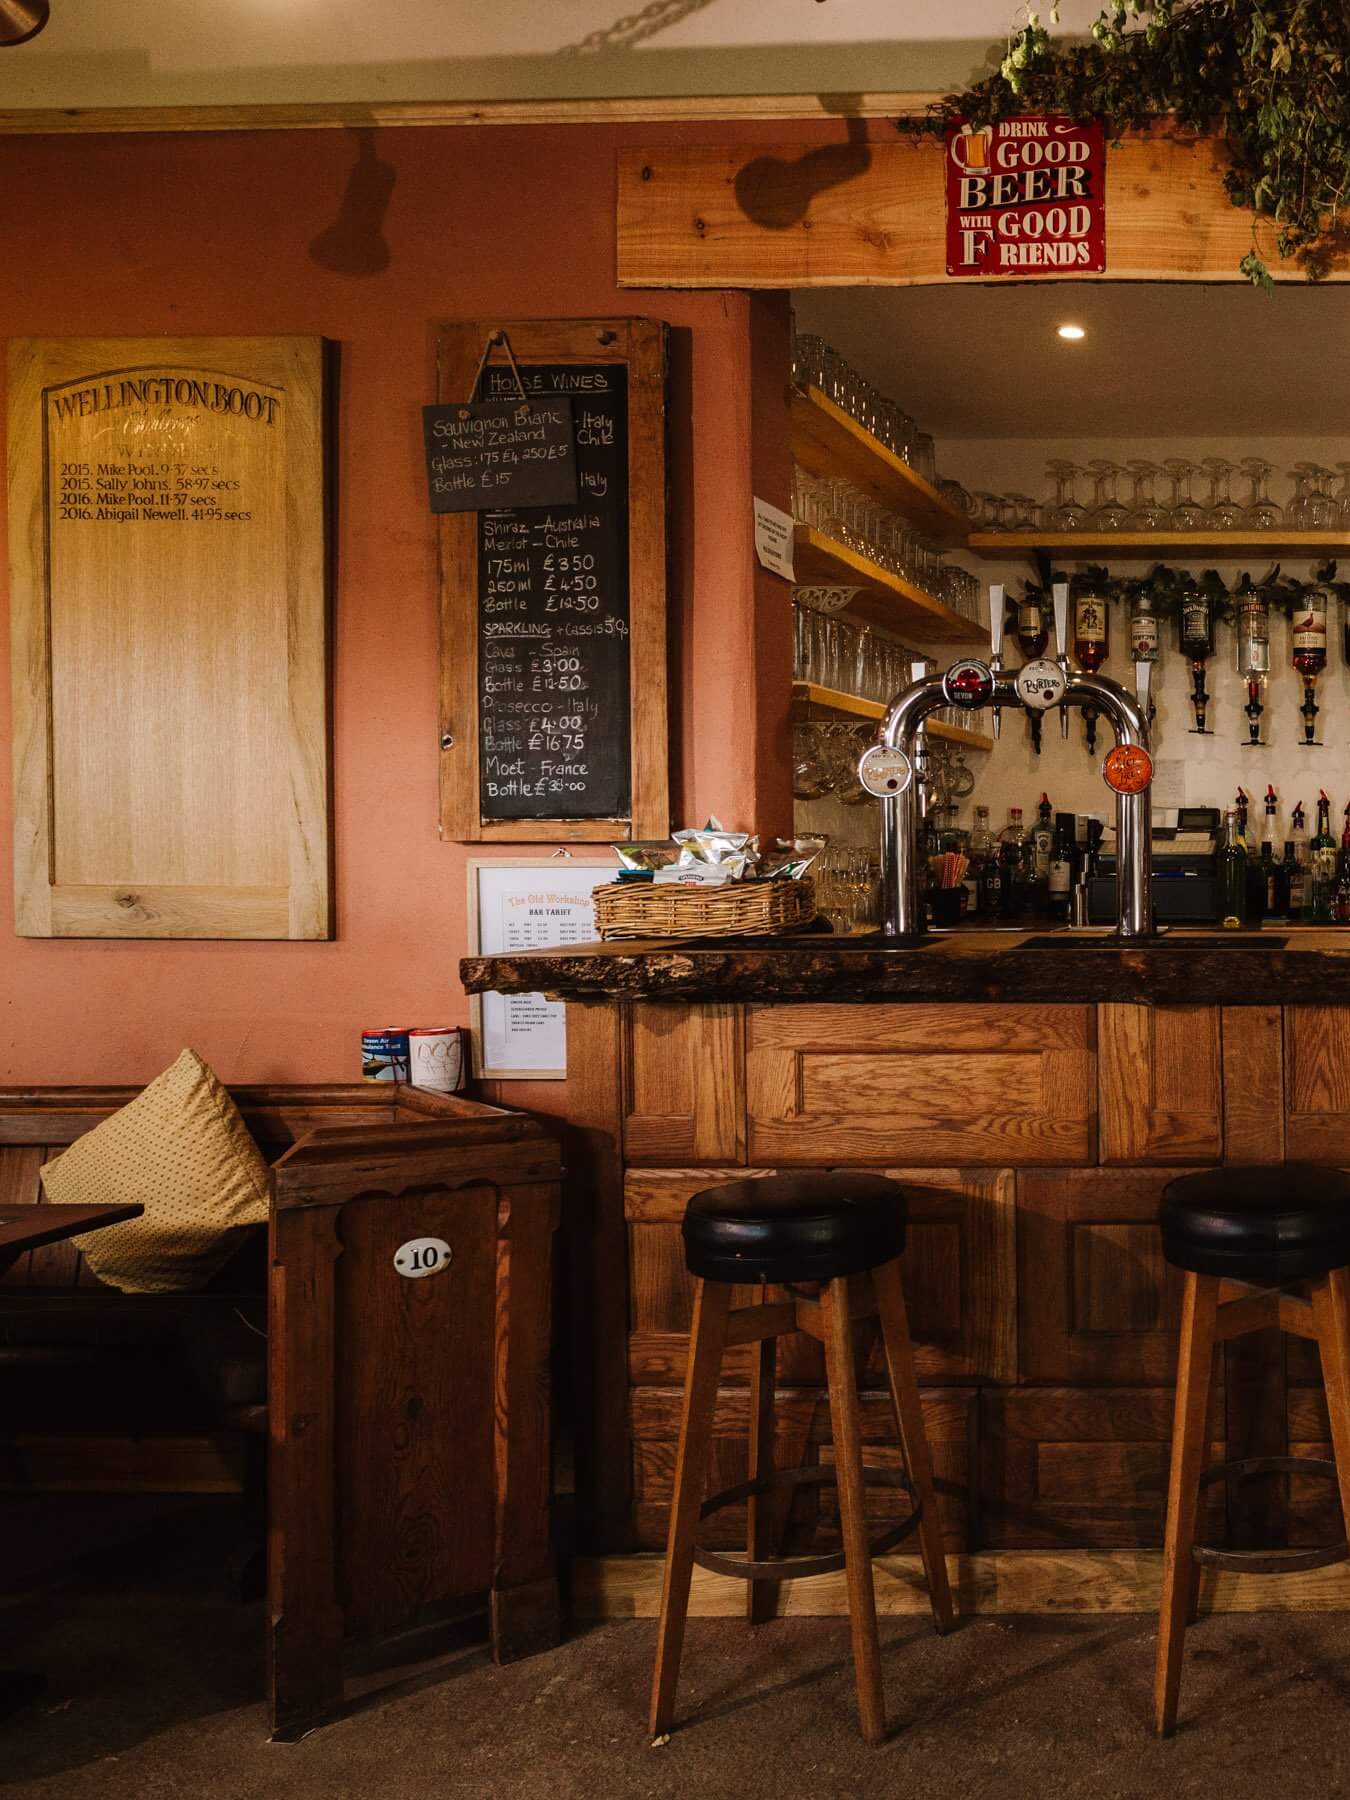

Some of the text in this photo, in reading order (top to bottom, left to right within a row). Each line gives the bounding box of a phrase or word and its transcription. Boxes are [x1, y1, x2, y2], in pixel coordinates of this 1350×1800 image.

[998, 121, 1050, 138] DRINK
[996, 141, 1091, 169] GOOD
[956, 165, 1089, 210] BEER
[959, 205, 1092, 239] WITH GOOD
[958, 229, 1091, 267] FRIENDS
[551, 373, 609, 389] WINES
[53, 377, 281, 425] WELLINGTON BOOT
[432, 415, 509, 439] Sauvignon
[583, 411, 613, 435] Italy
[453, 438, 485, 450] New
[488, 427, 545, 447] Zealand
[577, 429, 615, 446] Chile
[96, 463, 127, 476] Mike
[191, 465, 219, 476] secs
[96, 477, 129, 491] Sally
[211, 479, 241, 490] secs
[432, 474, 476, 493] Bottle
[580, 472, 608, 497] Italy
[96, 492, 127, 506] Mike
[190, 495, 217, 506] secs
[96, 507, 139, 523] Abigail
[224, 510, 252, 521] secs
[484, 519, 530, 536] Shiraz
[484, 537, 529, 551] Merlot
[545, 534, 580, 549] Chile
[483, 596, 529, 613] Bottle
[482, 621, 553, 637] SPARKLING
[484, 641, 516, 659] Cava
[539, 642, 581, 661] Spain
[485, 661, 523, 673] Glass
[484, 676, 525, 693] Bottle
[482, 695, 552, 714] Prosecco
[567, 697, 599, 721] Italy
[483, 717, 523, 735] Glass
[484, 736, 524, 753] Bottle
[540, 760, 589, 776] France
[486, 778, 533, 797] Bottle
[410, 1246, 439, 1271] 10
